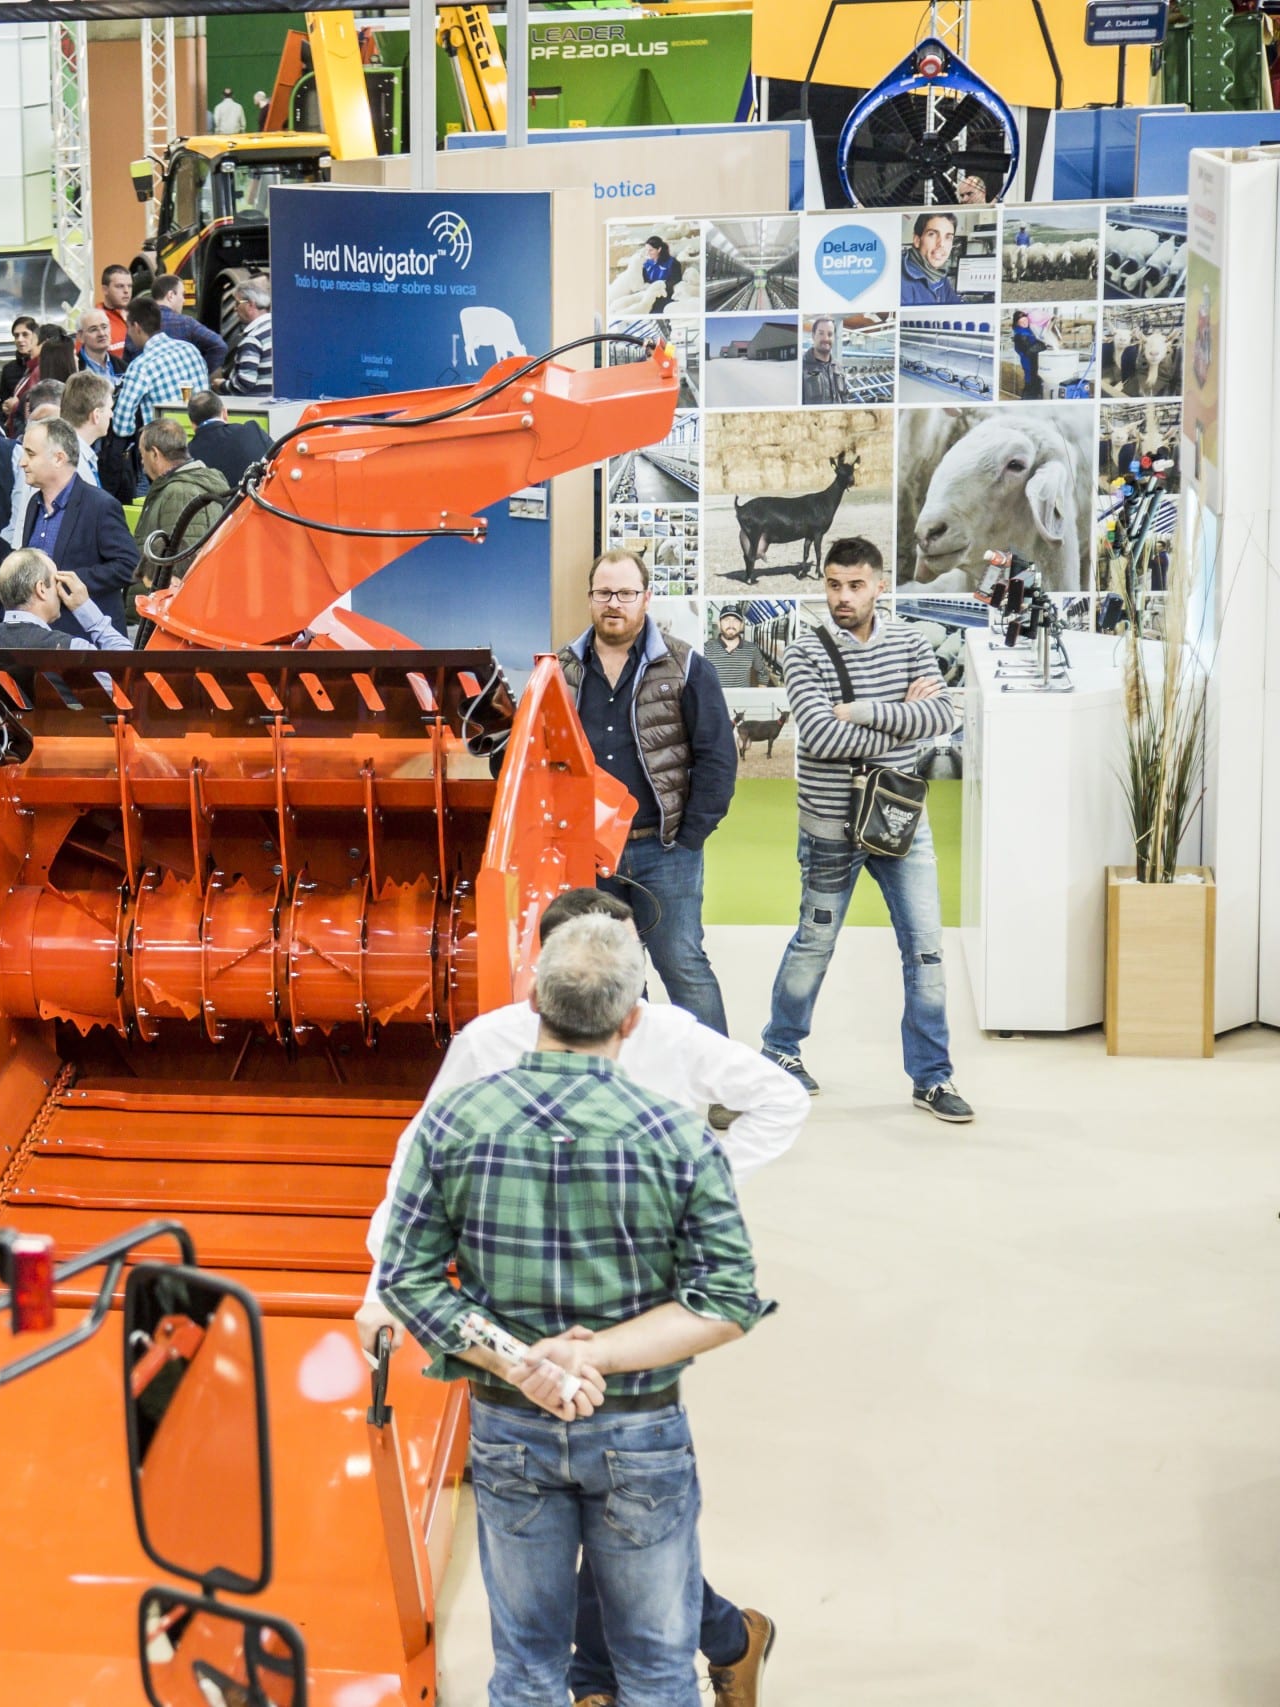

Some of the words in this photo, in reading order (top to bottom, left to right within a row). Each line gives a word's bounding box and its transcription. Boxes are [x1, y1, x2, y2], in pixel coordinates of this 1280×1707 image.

[1115, 19, 1149, 28] DeLaval
[531, 25, 625, 43] LEADER
[531, 46, 559, 60] PF
[562, 44, 607, 59] 2.20
[611, 41, 668, 57] PLUS
[823, 240, 877, 254] DeLaval
[303, 242, 340, 272] Herd
[823, 255, 873, 269] DelPro
[294, 273, 311, 288] Todo
[312, 275, 319, 288] lo
[320, 278, 335, 293] que
[336, 278, 371, 293] necesita
[373, 280, 399, 294] saber
[402, 281, 431, 295] sobre
[433, 284, 447, 295] su
[450, 284, 477, 296] vaca
